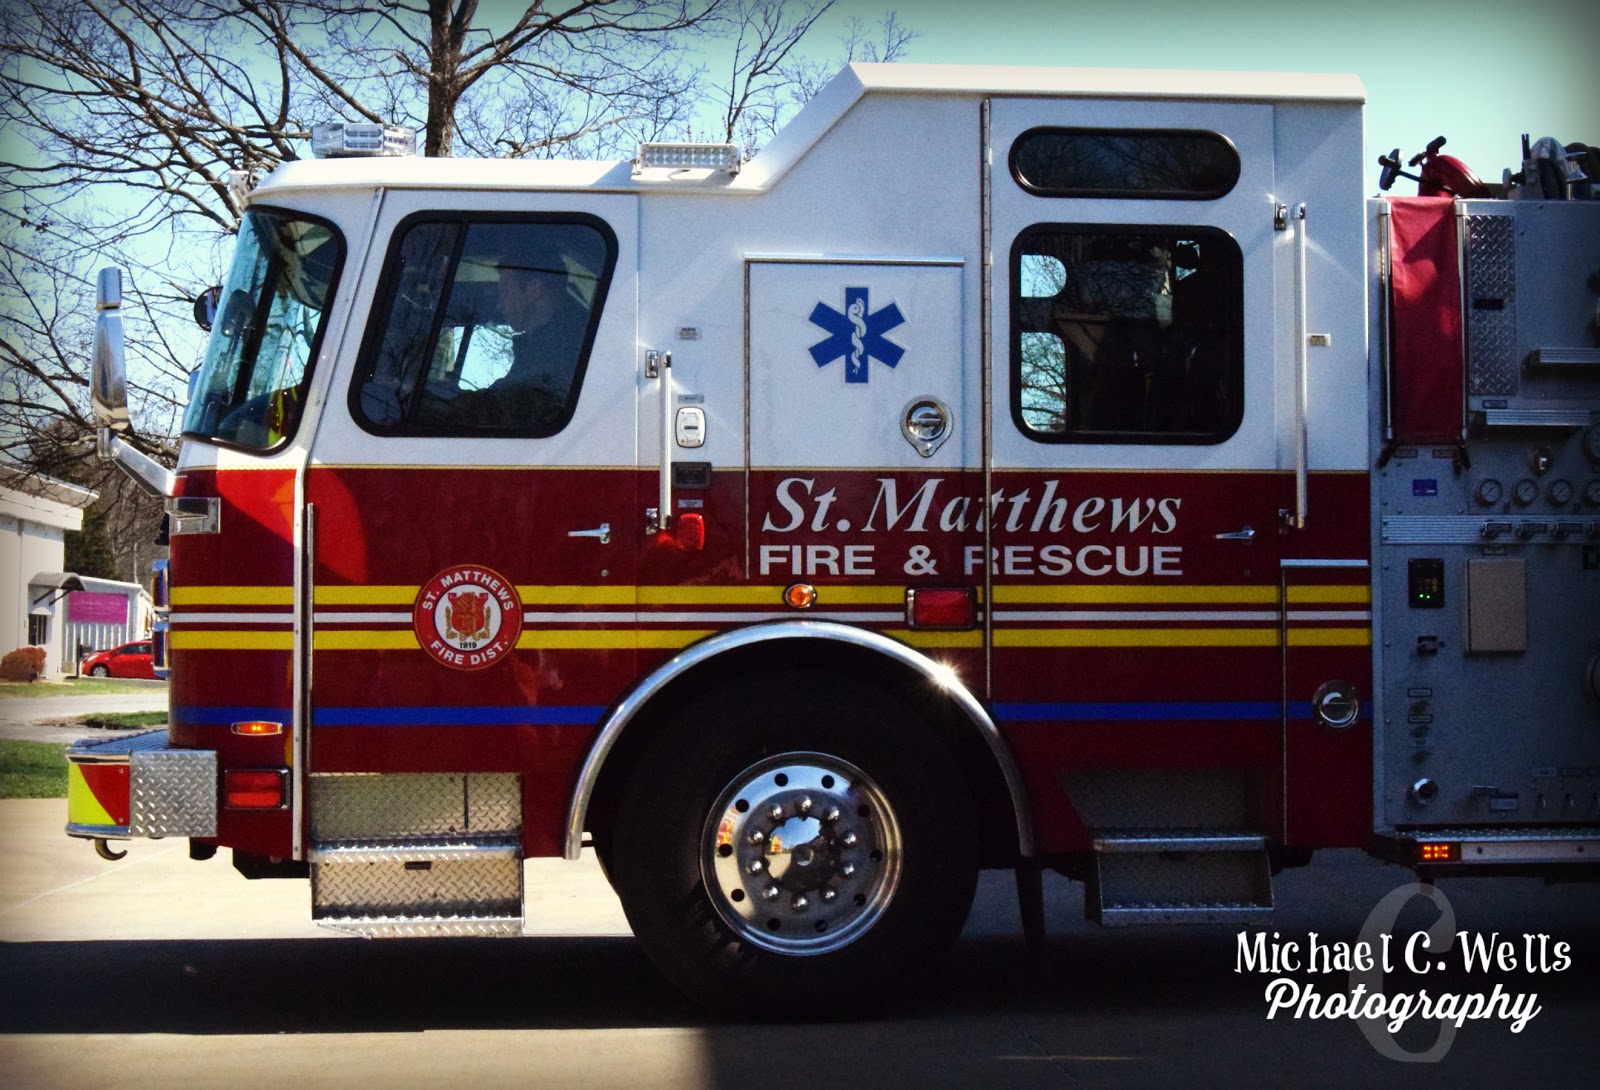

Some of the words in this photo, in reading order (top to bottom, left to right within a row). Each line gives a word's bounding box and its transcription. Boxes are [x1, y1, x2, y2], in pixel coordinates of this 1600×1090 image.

[762, 477, 850, 533] St.
[861, 477, 1182, 533] Matthews
[759, 545, 876, 576] FIRE
[903, 544, 939, 576] &
[963, 545, 1183, 577] RESCUE
[422, 590, 440, 611] ST.
[440, 570, 514, 611] MATTHEWS
[430, 640, 464, 665] FIRE
[470, 641, 509, 665] DIST.
[459, 641, 478, 649] 1919
